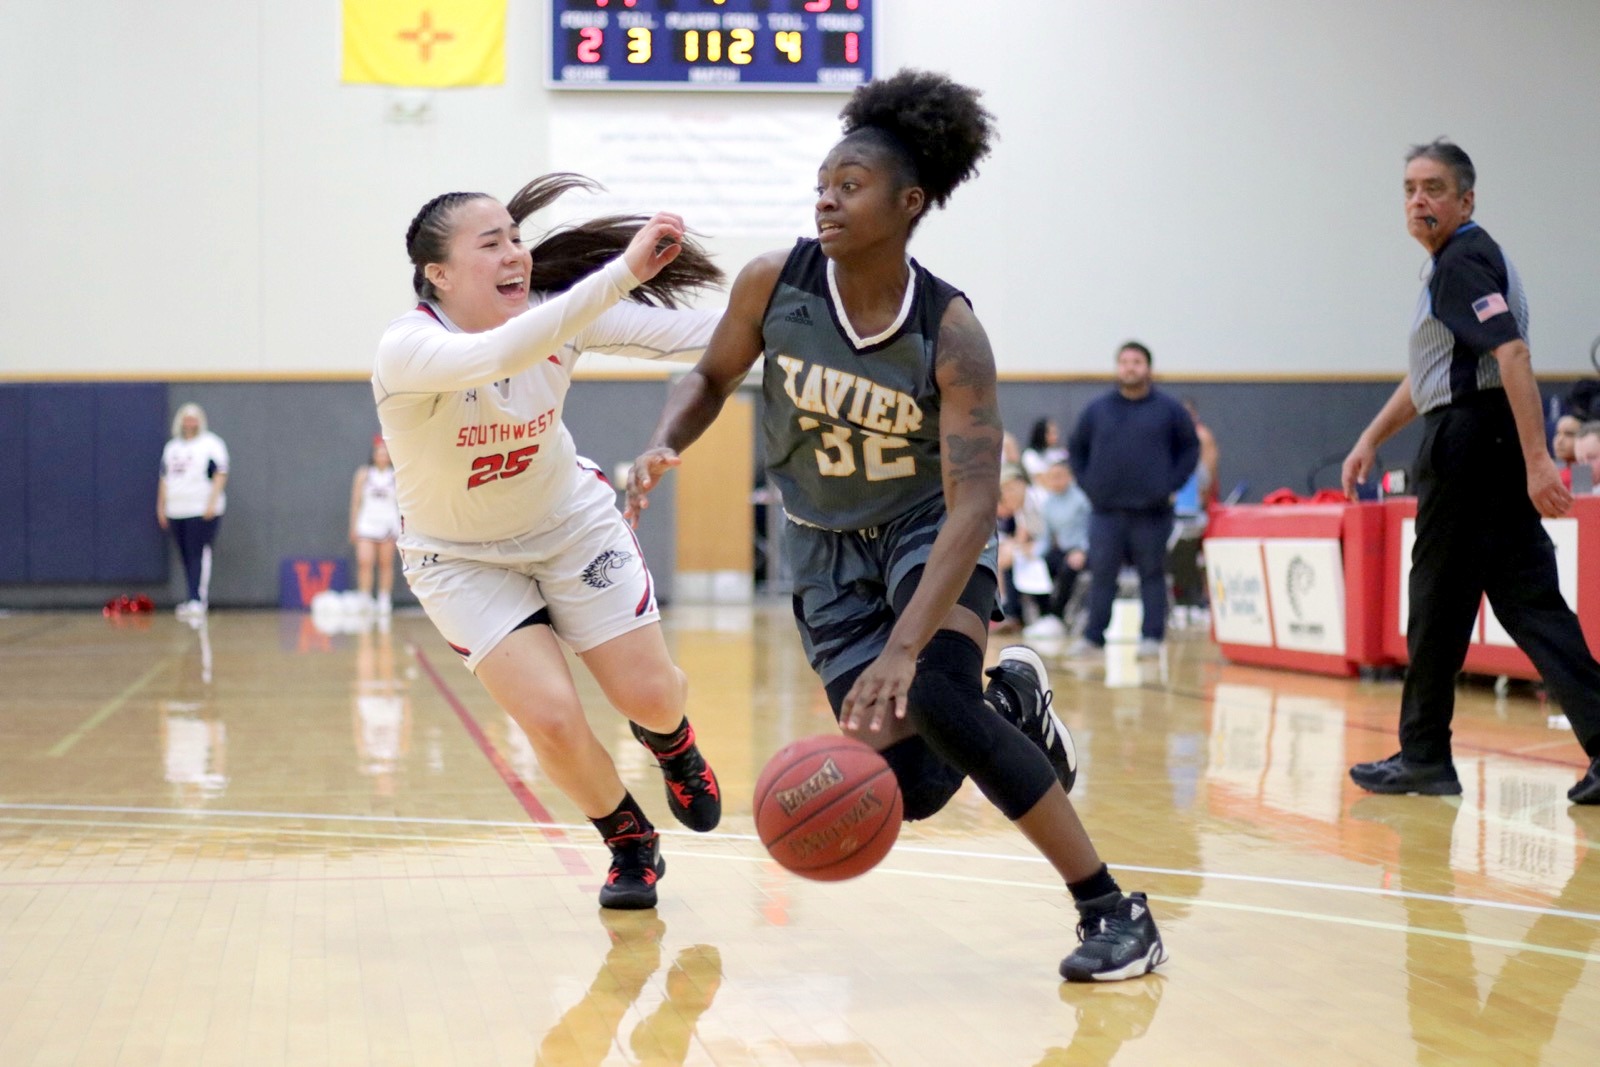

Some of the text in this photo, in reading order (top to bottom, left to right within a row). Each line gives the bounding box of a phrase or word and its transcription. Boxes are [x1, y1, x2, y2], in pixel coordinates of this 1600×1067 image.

[577, 26, 603, 64] 2
[626, 26, 652, 64] 3
[774, 30, 802, 63] 4
[844, 31, 859, 63] 1
[456, 408, 556, 448] SOUTHWEST
[467, 444, 540, 491] 25
